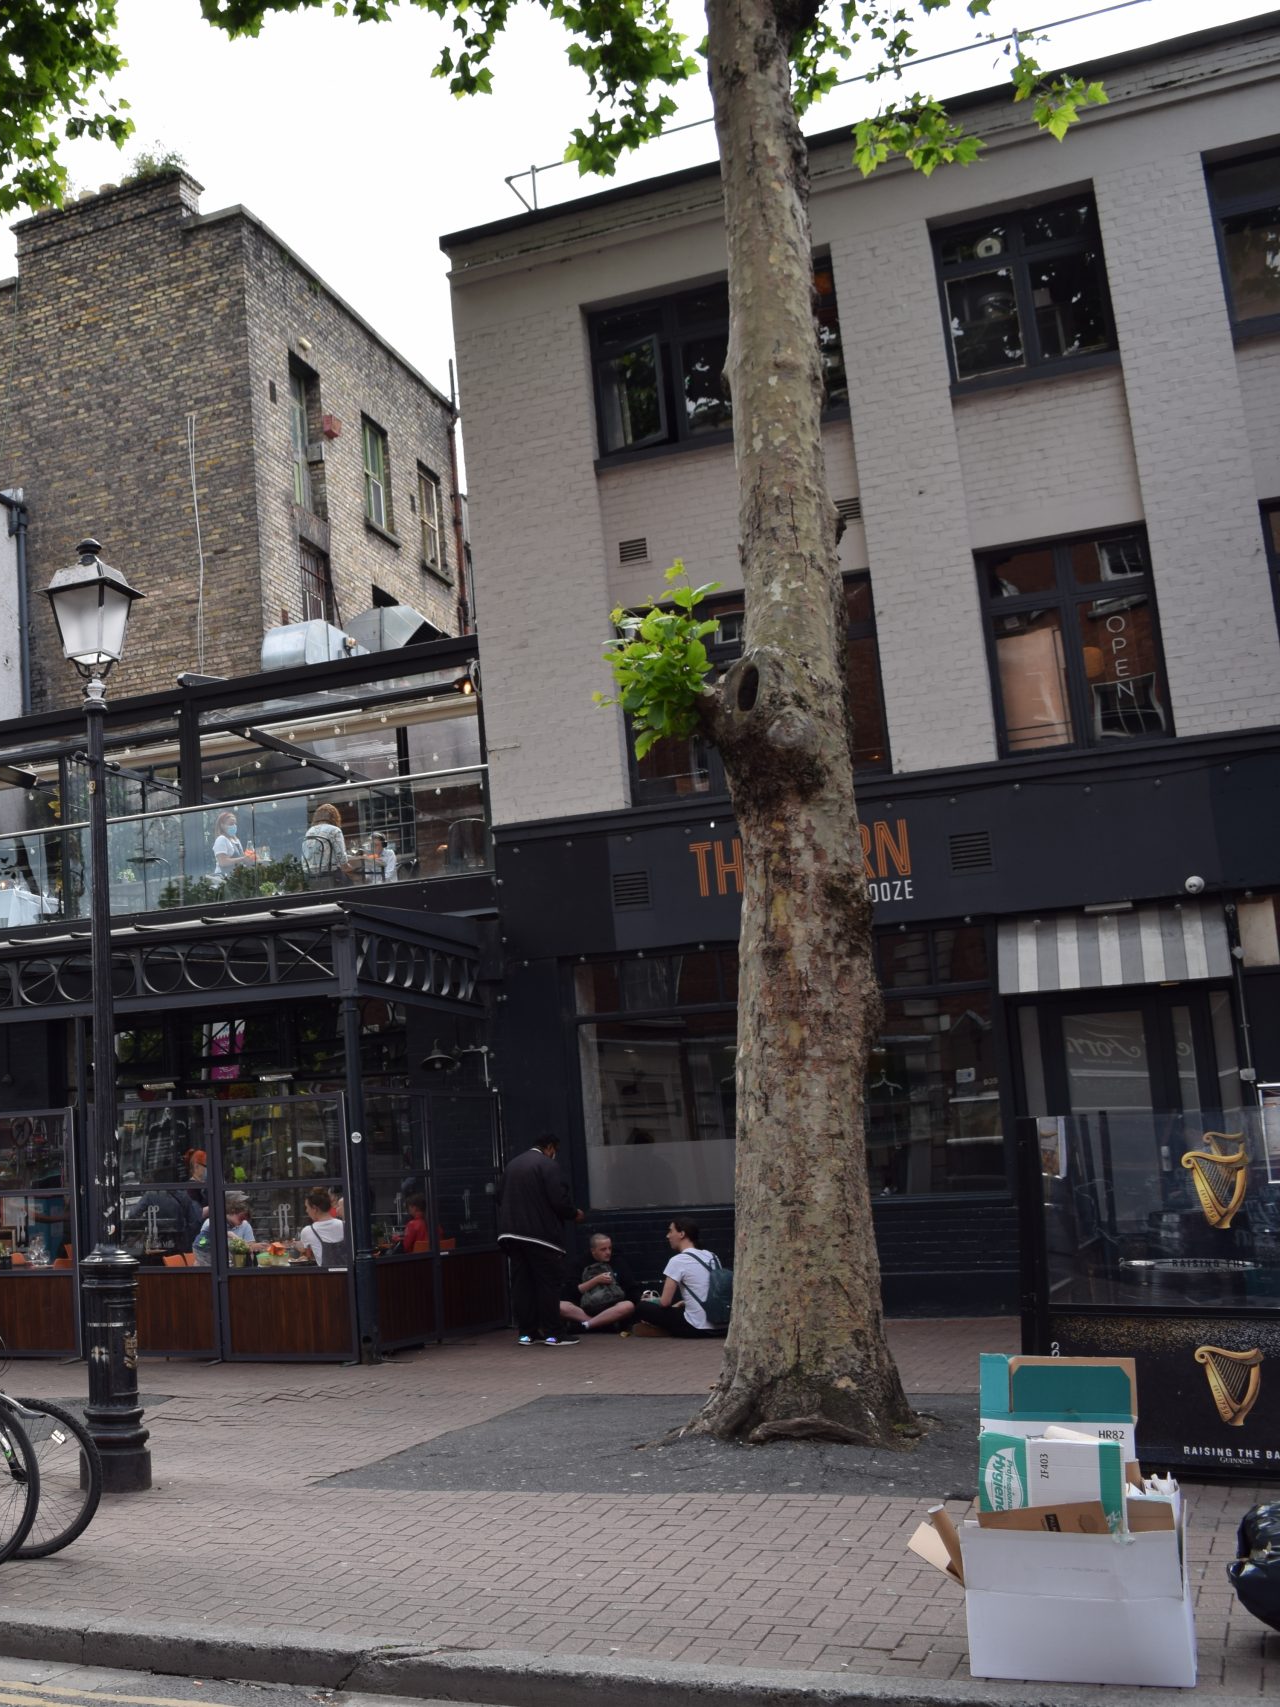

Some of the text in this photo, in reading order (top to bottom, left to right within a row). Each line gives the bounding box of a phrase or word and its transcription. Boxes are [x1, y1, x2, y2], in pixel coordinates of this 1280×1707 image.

[1106, 615, 1135, 698] OPEN
[689, 838, 744, 897] TH
[869, 880, 914, 902] OOZE
[1098, 1429, 1125, 1441] HR82
[1183, 1445, 1280, 1460] RAISING THE BA
[1219, 1456, 1255, 1465] GUINNESS
[1039, 1453, 1050, 1479] ZF403
[1005, 1458, 1015, 1511] Professiona
